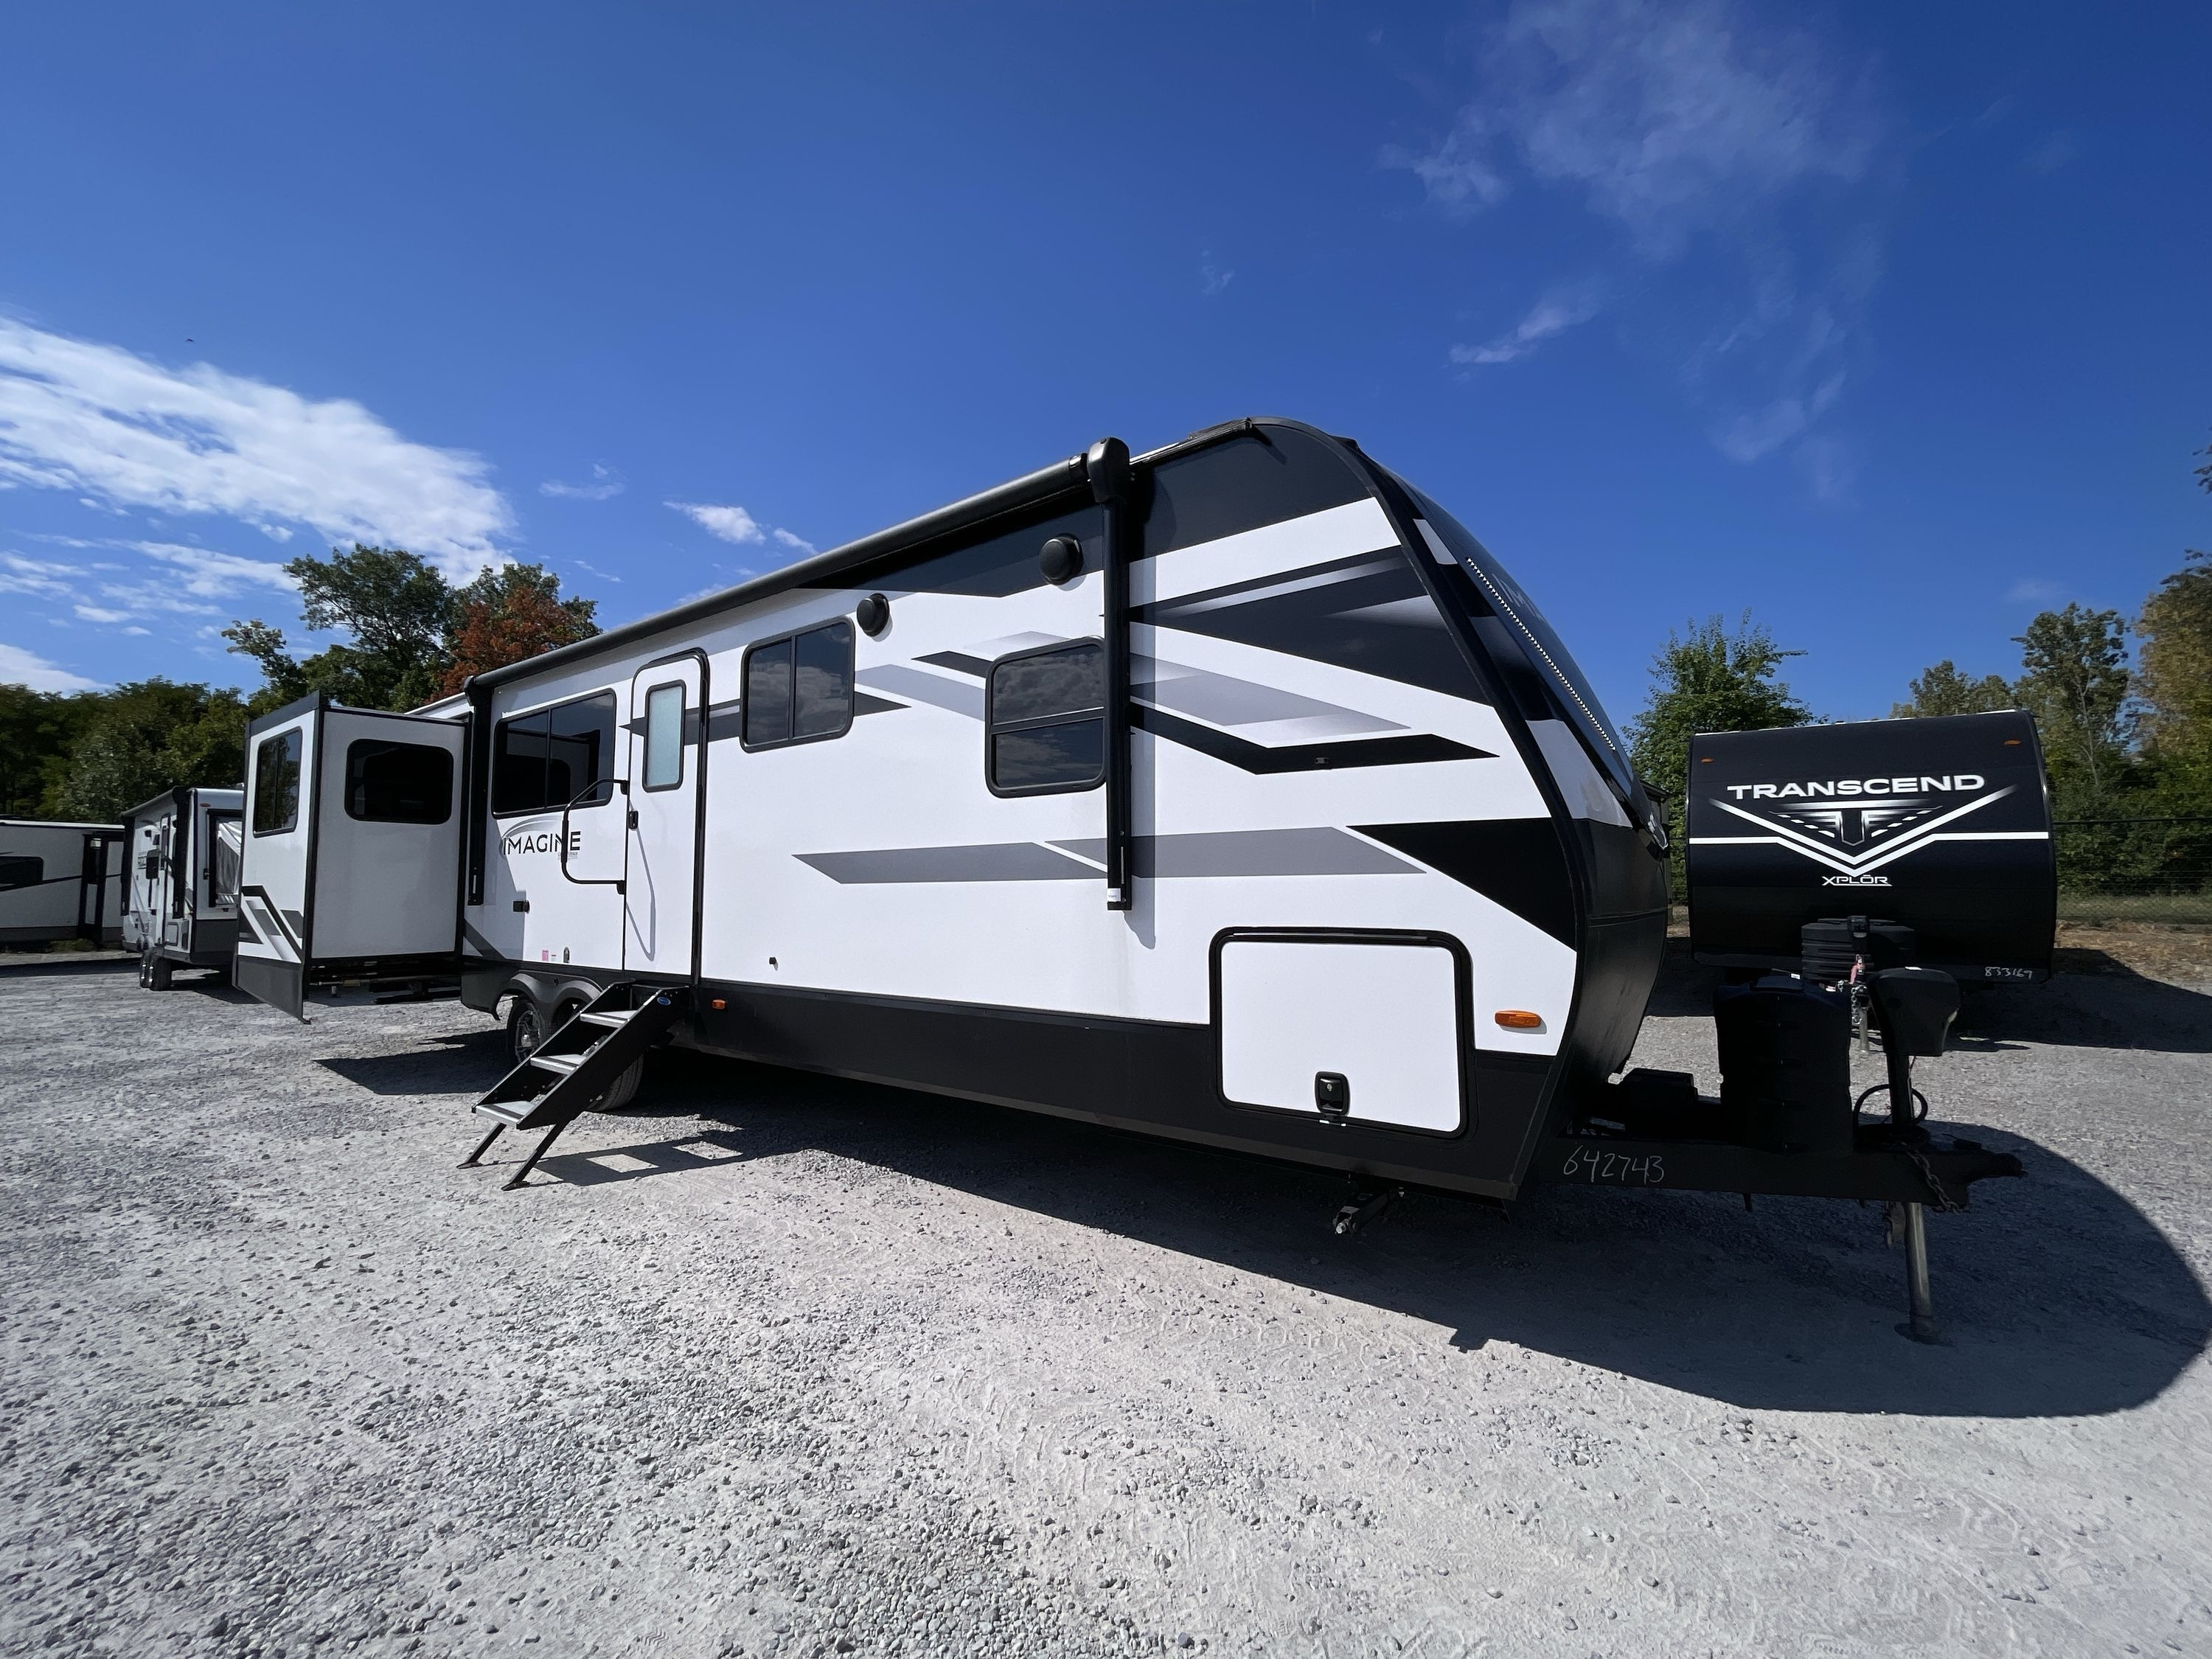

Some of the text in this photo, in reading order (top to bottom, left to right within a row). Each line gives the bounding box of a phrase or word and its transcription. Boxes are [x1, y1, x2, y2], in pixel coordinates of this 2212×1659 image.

[1726, 774, 1986, 800] TRANSCEND
[503, 831, 581, 855] IMAGINE
[1563, 1144, 1665, 1186] 642743
